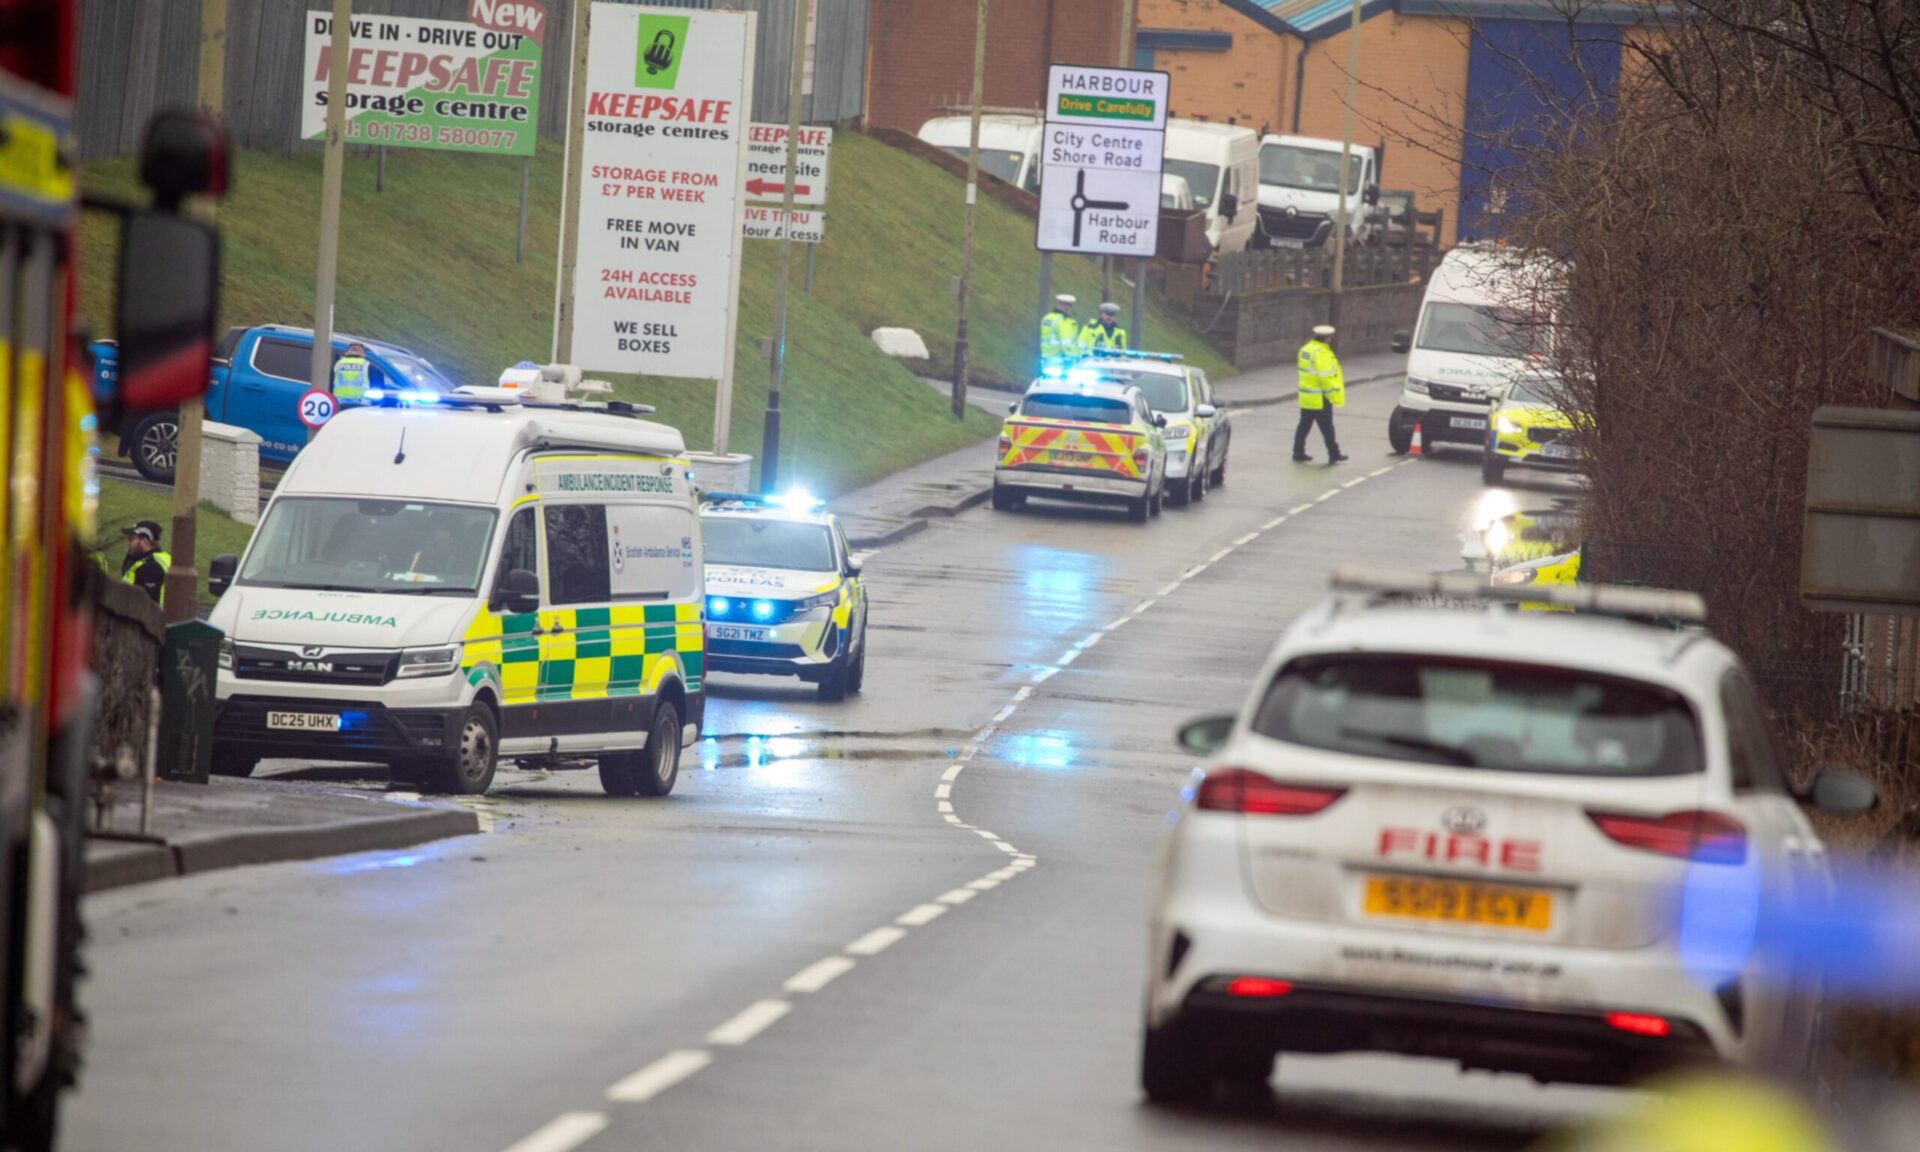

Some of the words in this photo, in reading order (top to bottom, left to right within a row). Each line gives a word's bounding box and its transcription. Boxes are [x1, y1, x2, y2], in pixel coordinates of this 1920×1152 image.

[472, 0, 543, 32] New
[380, 24, 399, 41] IN
[418, 27, 476, 47] DRIVE
[482, 32, 523, 51] OUT
[1062, 74, 1154, 95] HARBOUR
[315, 91, 423, 115] sorage
[435, 101, 528, 122] centre
[587, 92, 732, 125] KEEPSAFE
[1060, 98, 1092, 111] Drive
[1097, 100, 1152, 118] Carefully
[367, 122, 431, 141] 01738
[439, 129, 516, 149] 580077
[587, 121, 656, 137] storage
[662, 125, 729, 141] centres
[1054, 131, 1084, 148] City
[1091, 134, 1143, 150] Centre
[1052, 148, 1096, 164] Shore
[1104, 152, 1143, 168] Road
[591, 165, 667, 183] STORAGE
[672, 171, 718, 187] FROM
[602, 184, 621, 197] £7
[627, 185, 655, 199] PER
[661, 189, 705, 203] WEEK
[607, 218, 643, 233] FREE
[648, 222, 696, 236] MOVE
[1088, 213, 1149, 230] Harbour
[620, 237, 639, 250] IN
[644, 238, 680, 252] VAN
[1099, 230, 1136, 245] Road
[601, 269, 633, 283] 24H
[638, 272, 697, 287] ACCESS
[604, 286, 692, 305] AVAILABLE
[613, 321, 637, 334] WE
[643, 323, 678, 337] SELL
[618, 339, 671, 354] BOXES
[304, 401, 331, 417] 20
[558, 473, 603, 491] AMBULANCE
[603, 474, 636, 492] INCIDENT
[637, 475, 673, 493] RESPONSE
[706, 576, 784, 587] POILEAS
[716, 627, 740, 639] SG21
[744, 628, 764, 640] TMZ
[287, 661, 333, 672] MAN
[271, 714, 304, 727] DC25
[308, 714, 333, 728] UHX
[1379, 828, 1541, 871] FIRE
